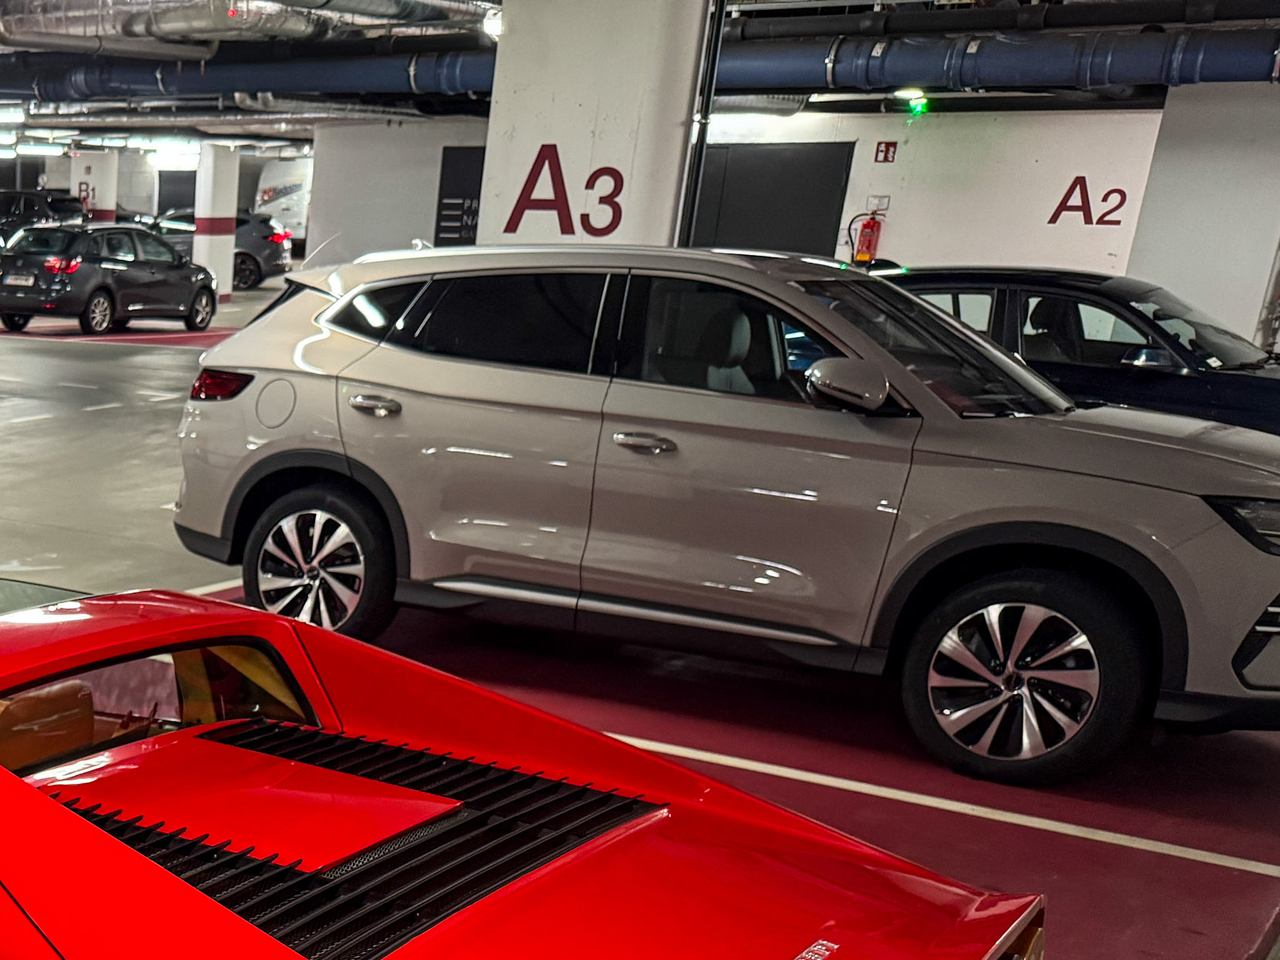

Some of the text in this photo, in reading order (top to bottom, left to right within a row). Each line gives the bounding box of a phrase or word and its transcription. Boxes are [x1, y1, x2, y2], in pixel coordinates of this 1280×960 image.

[78, 181, 96, 200] B1
[463, 198, 479, 210] PR
[503, 143, 624, 238] A3
[1047, 176, 1127, 226] A2
